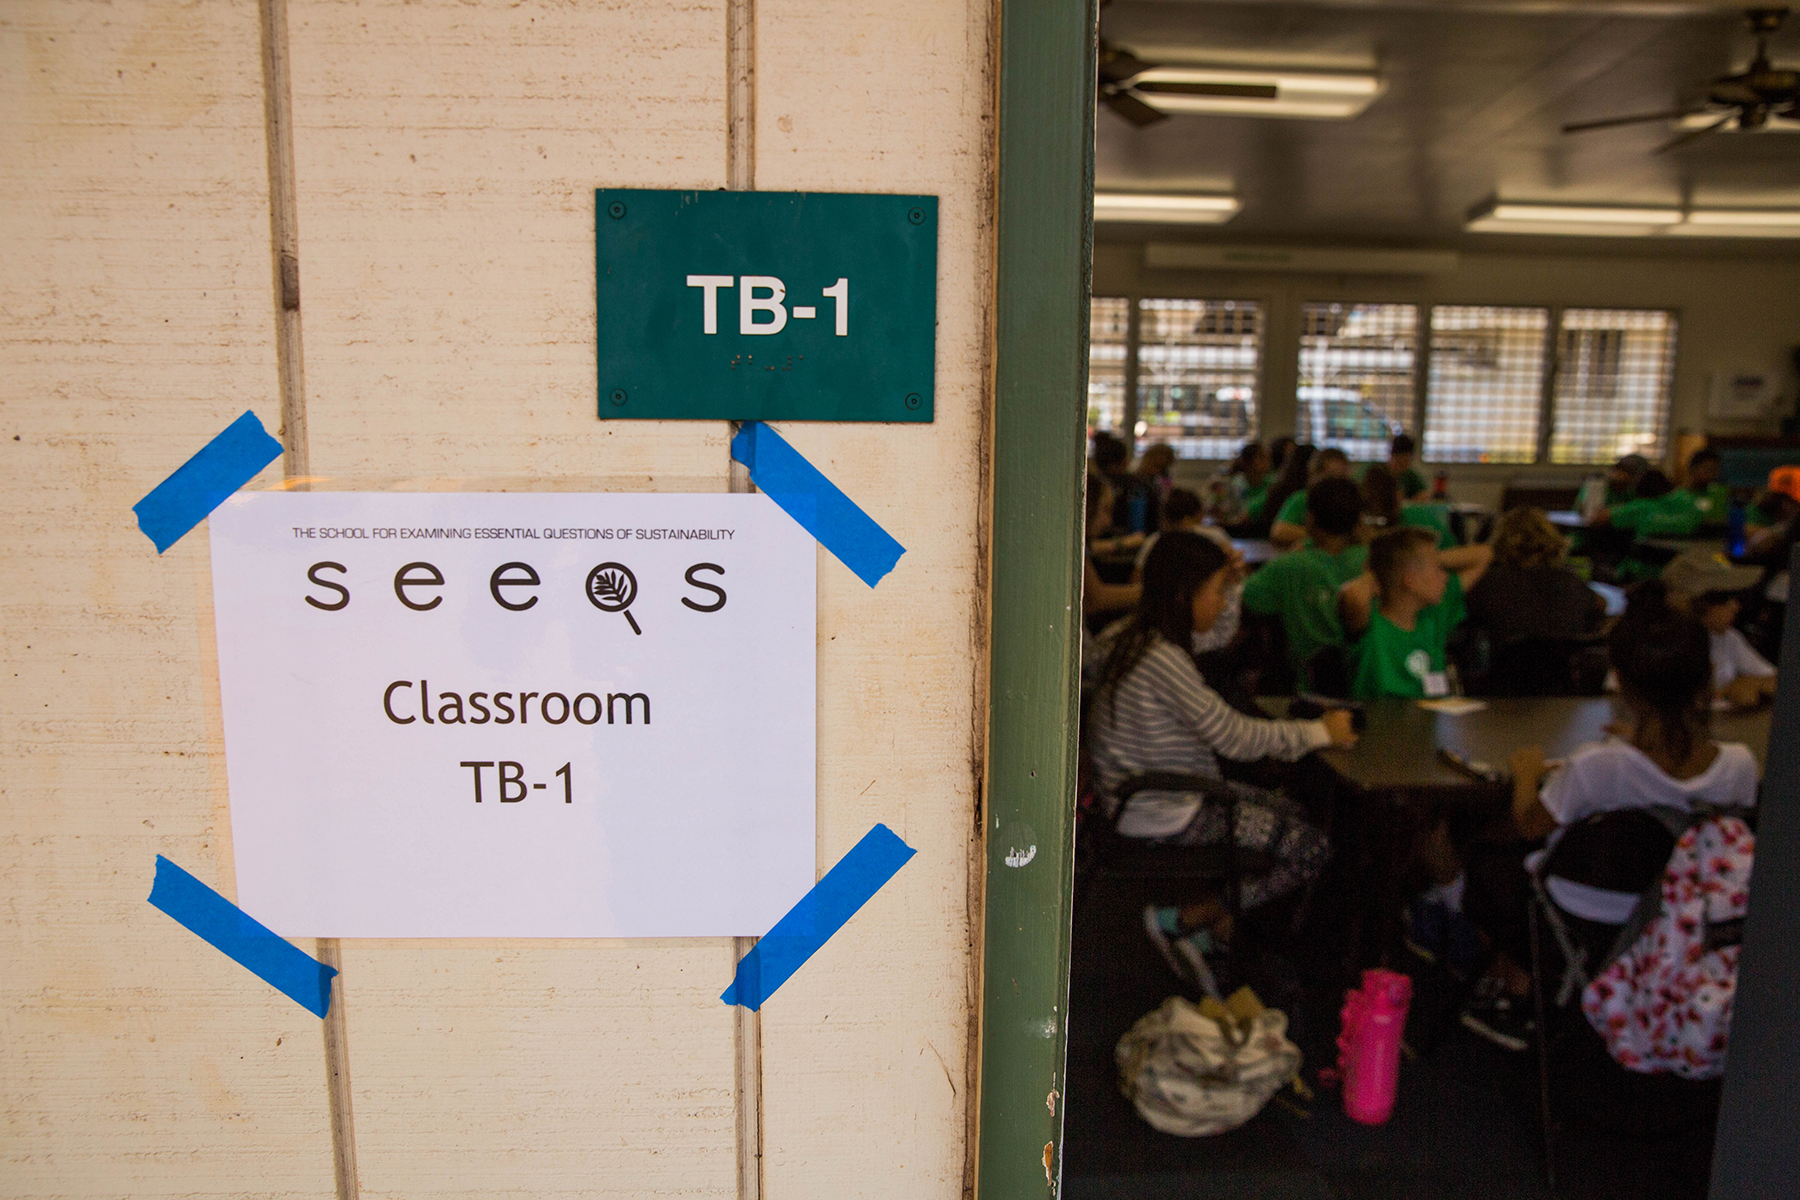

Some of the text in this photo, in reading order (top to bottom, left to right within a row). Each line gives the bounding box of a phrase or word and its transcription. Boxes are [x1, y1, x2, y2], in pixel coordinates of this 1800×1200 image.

[686, 275, 849, 336] TB-1
[292, 527, 736, 541] THE SCHOOL FOR EXAMINING ESSENTIAL QUESTIONS OF SUSTAINABILITY
[383, 679, 651, 725] Classroom
[459, 760, 572, 804] TB-1
